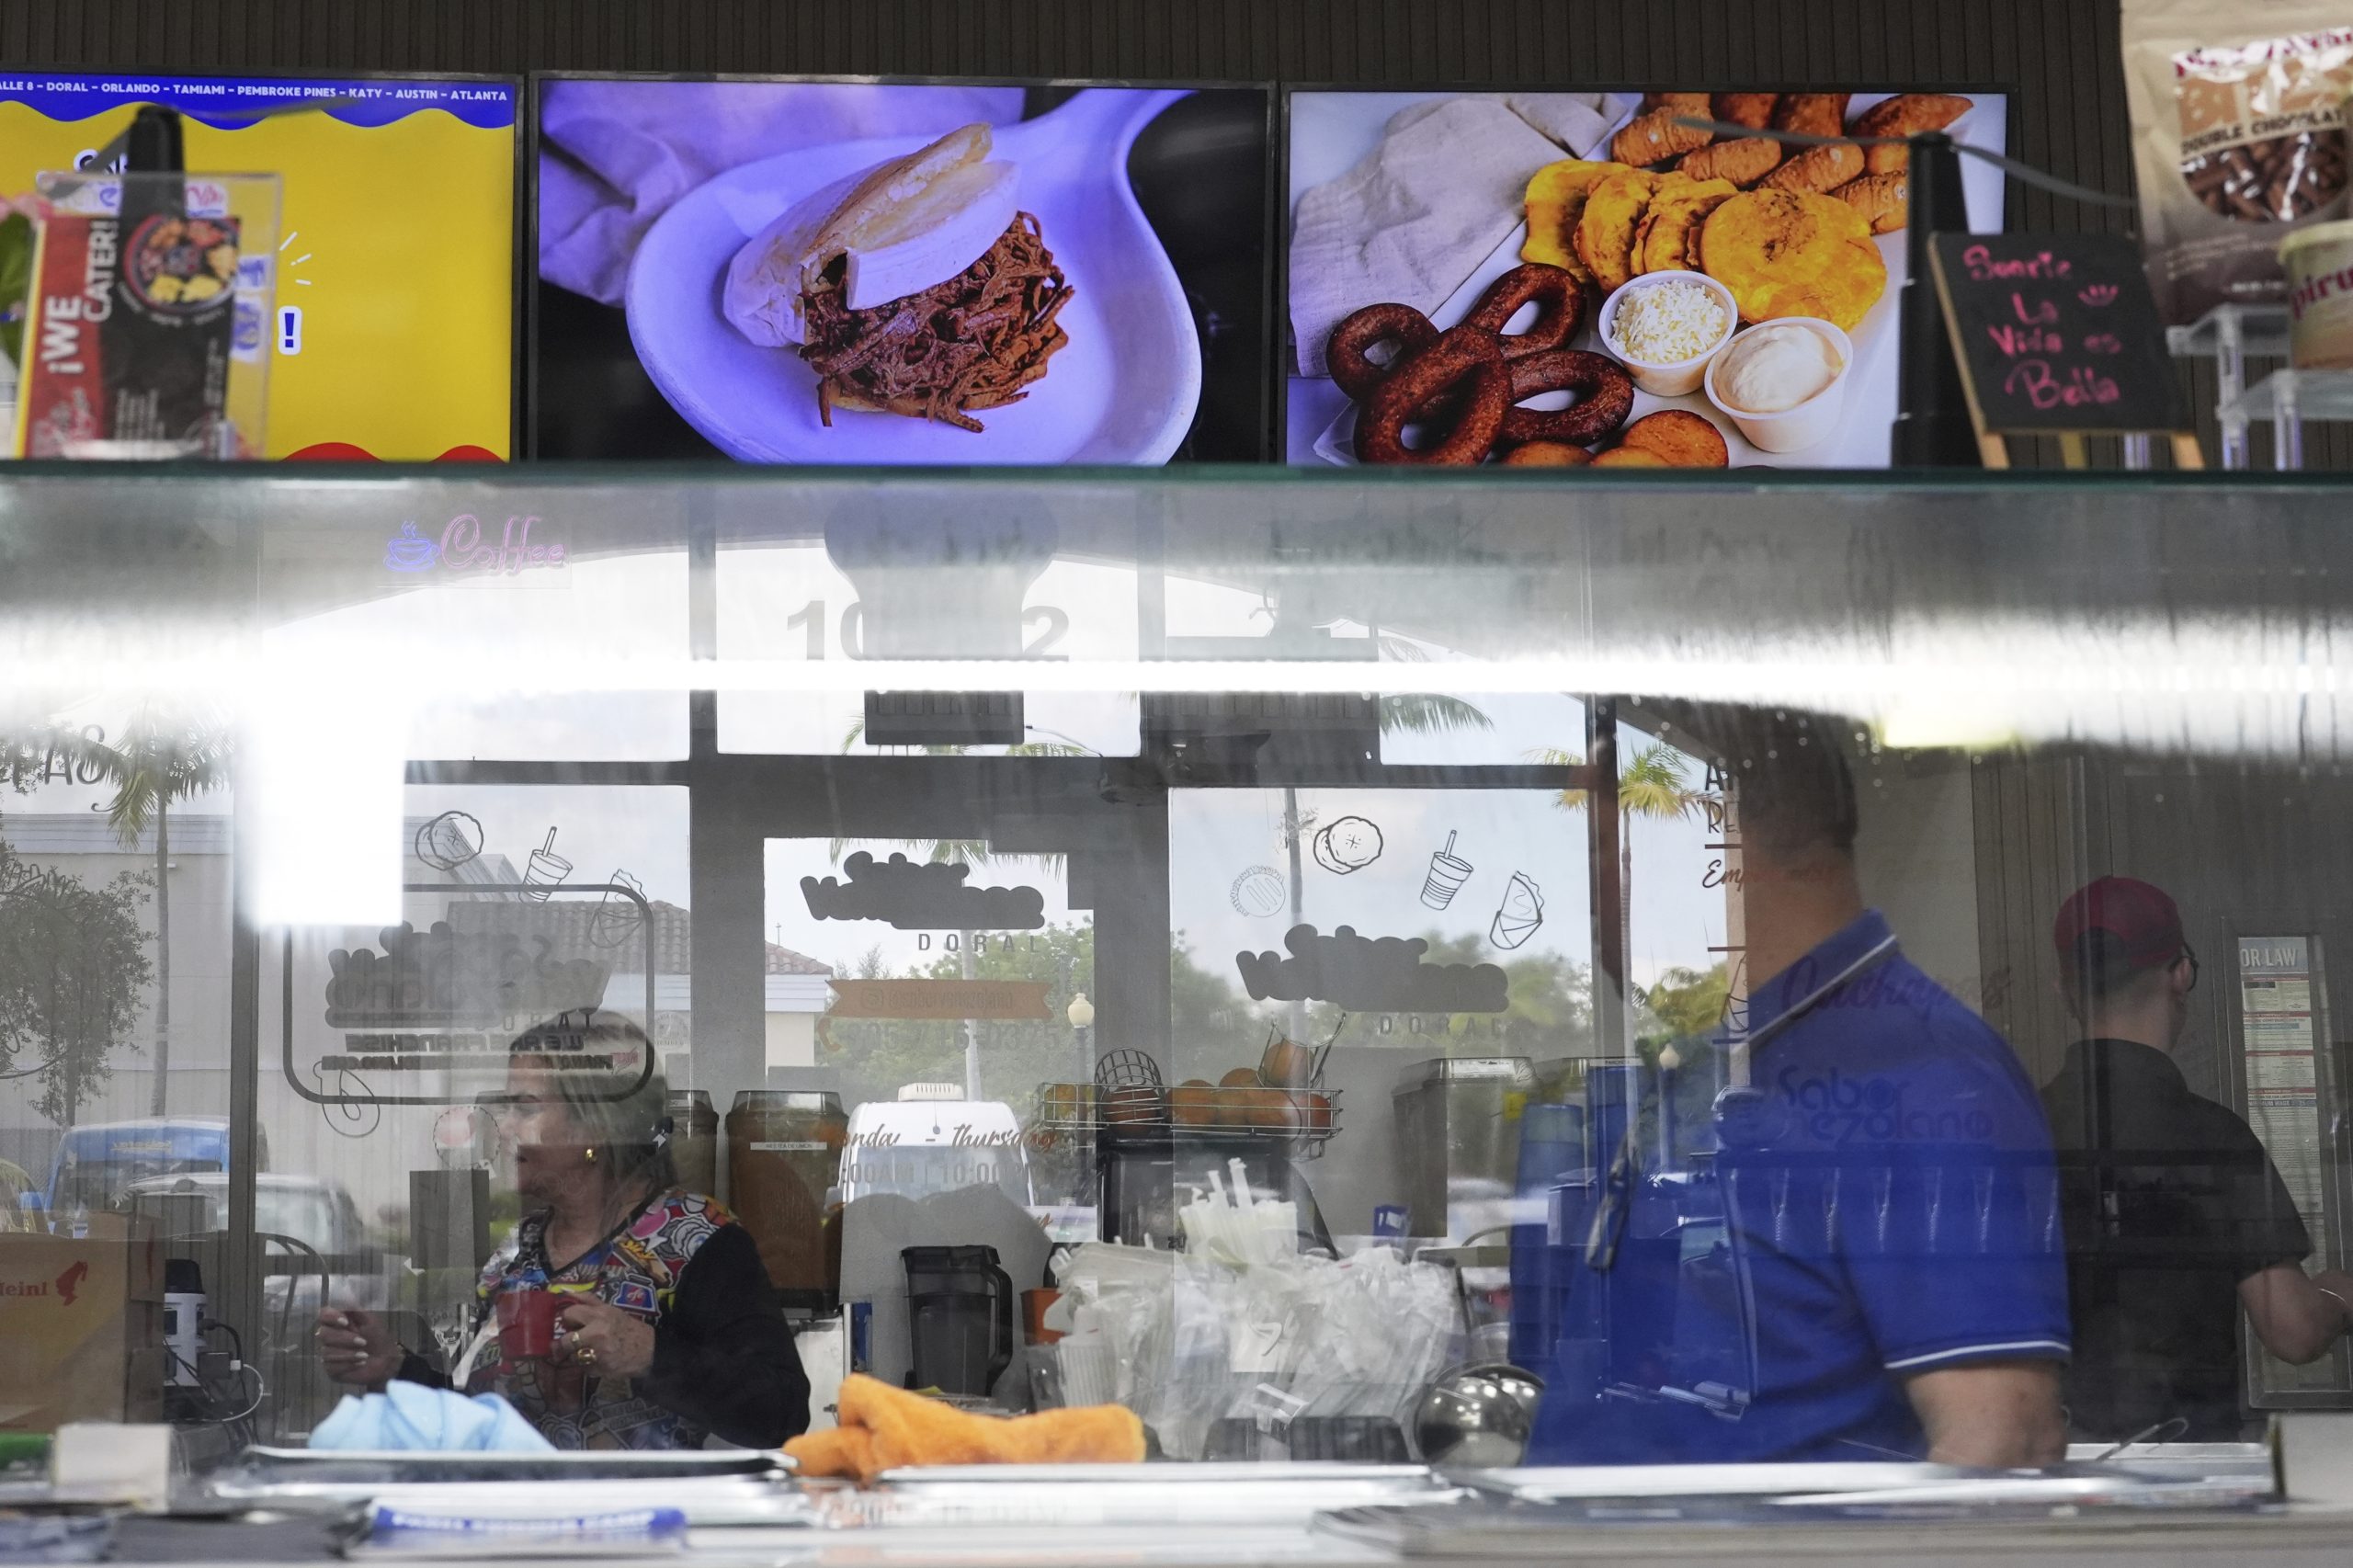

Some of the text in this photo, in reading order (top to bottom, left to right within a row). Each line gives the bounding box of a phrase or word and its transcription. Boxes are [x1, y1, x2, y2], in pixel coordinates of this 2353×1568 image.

[0, 81, 23, 91] LLE
[27, 81, 34, 91] 8
[47, 82, 88, 92] DORAL
[101, 83, 160, 93] ORLANDO
[174, 85, 225, 95] TAMIAMI
[237, 85, 301, 97] PEMBROKE
[304, 87, 336, 97] PINES
[349, 88, 382, 98] KATY
[395, 89, 438, 100] AUSTIN
[450, 90, 506, 101] ATLANTA
[81, 220, 119, 323] CATER!
[1962, 244, 2072, 281] Sonrie
[2010, 291, 2059, 325] La
[1986, 324, 2063, 358] Vida
[2004, 358, 2120, 409] Bella
[439, 514, 567, 575] Coffee
[917, 932, 1040, 953] DORAL
[2266, 948, 2297, 966] LAW
[1379, 1016, 1503, 1036] DORAL
[952, 1123, 1058, 1153] Thursday
[0, 1280, 49, 1296] einl
